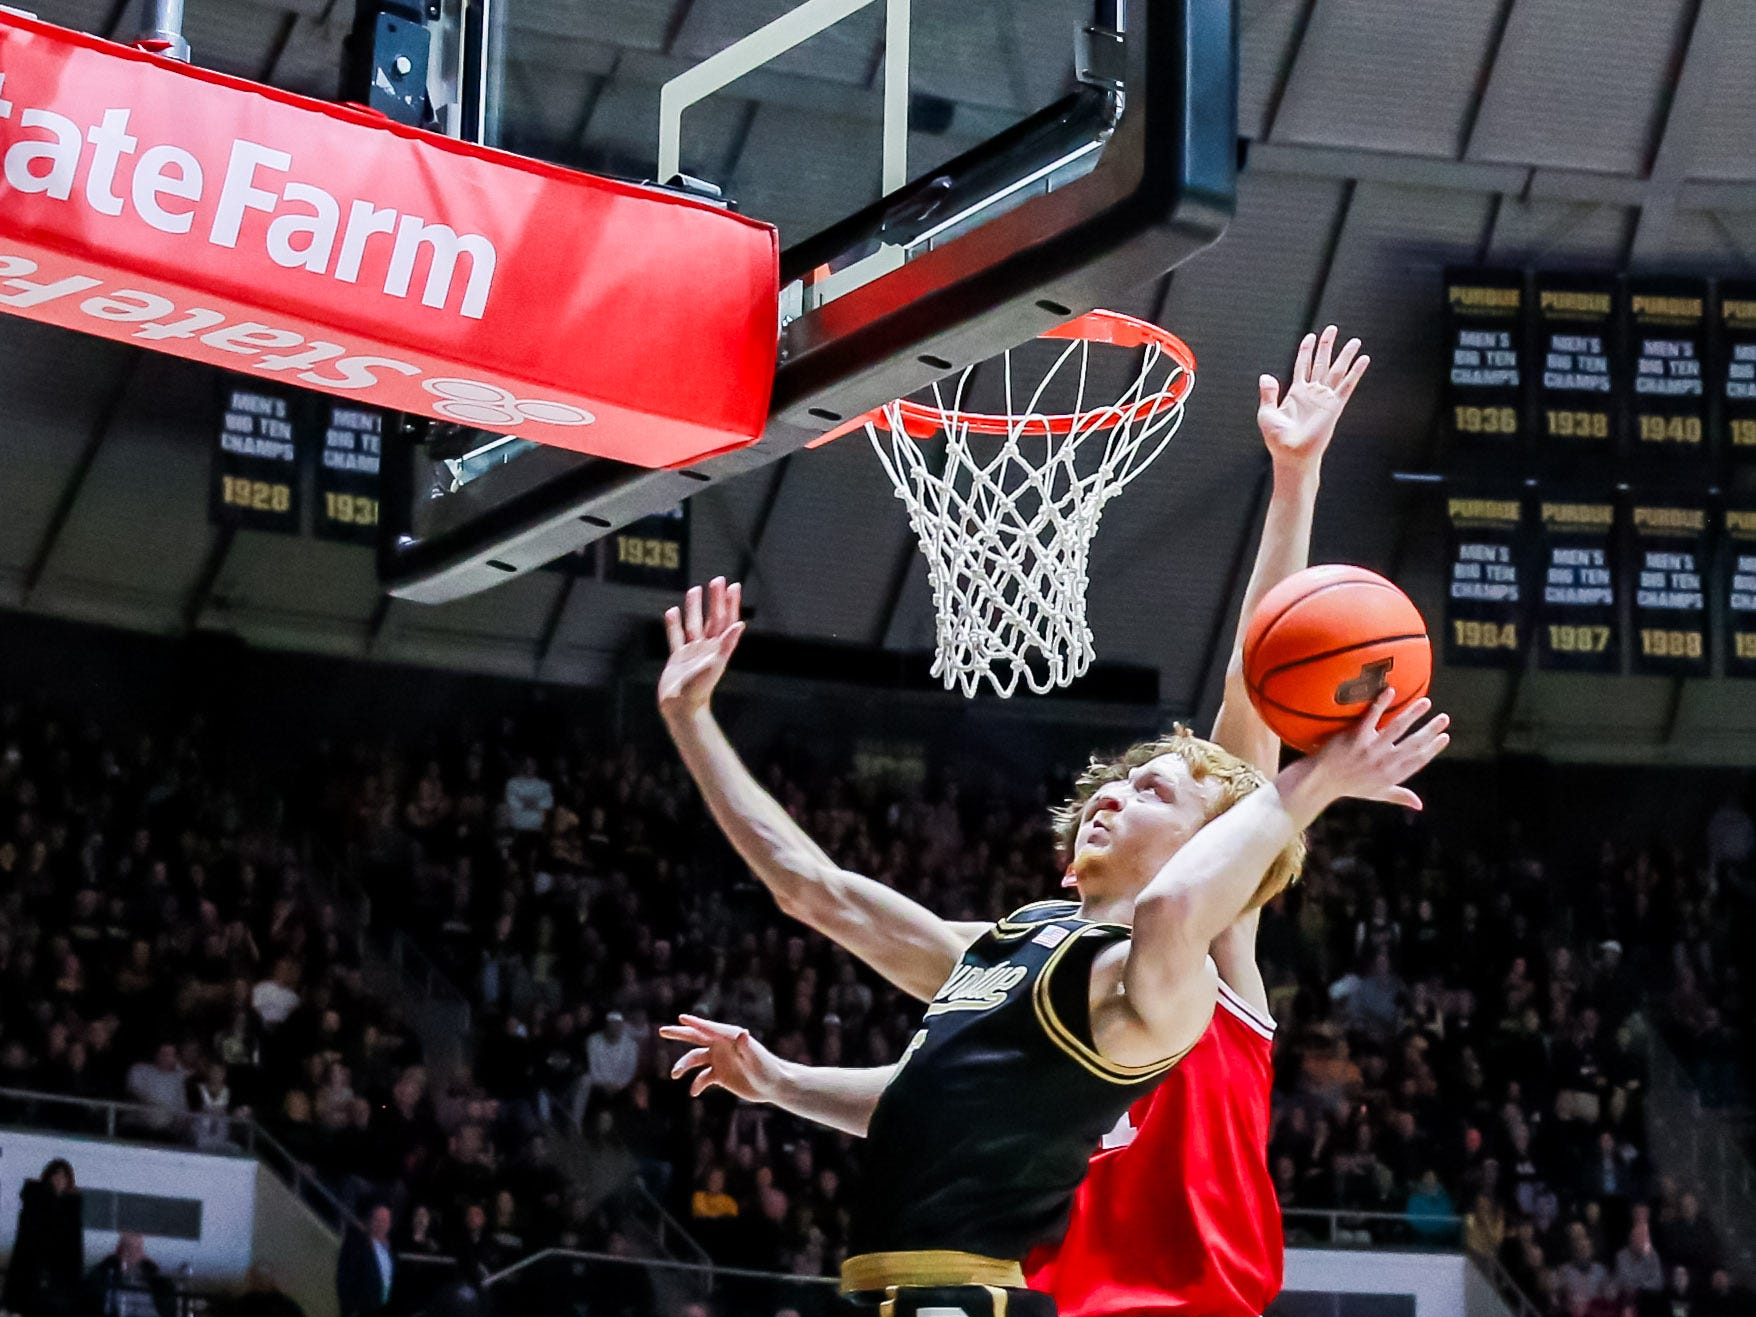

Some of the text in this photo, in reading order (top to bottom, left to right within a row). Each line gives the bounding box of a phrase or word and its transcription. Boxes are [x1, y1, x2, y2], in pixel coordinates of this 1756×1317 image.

[209, 138, 498, 320] Farm
[79, 288, 422, 389] State
[1639, 415, 1702, 443] 1940
[222, 476, 290, 512] 1928
[617, 535, 680, 569] 1935
